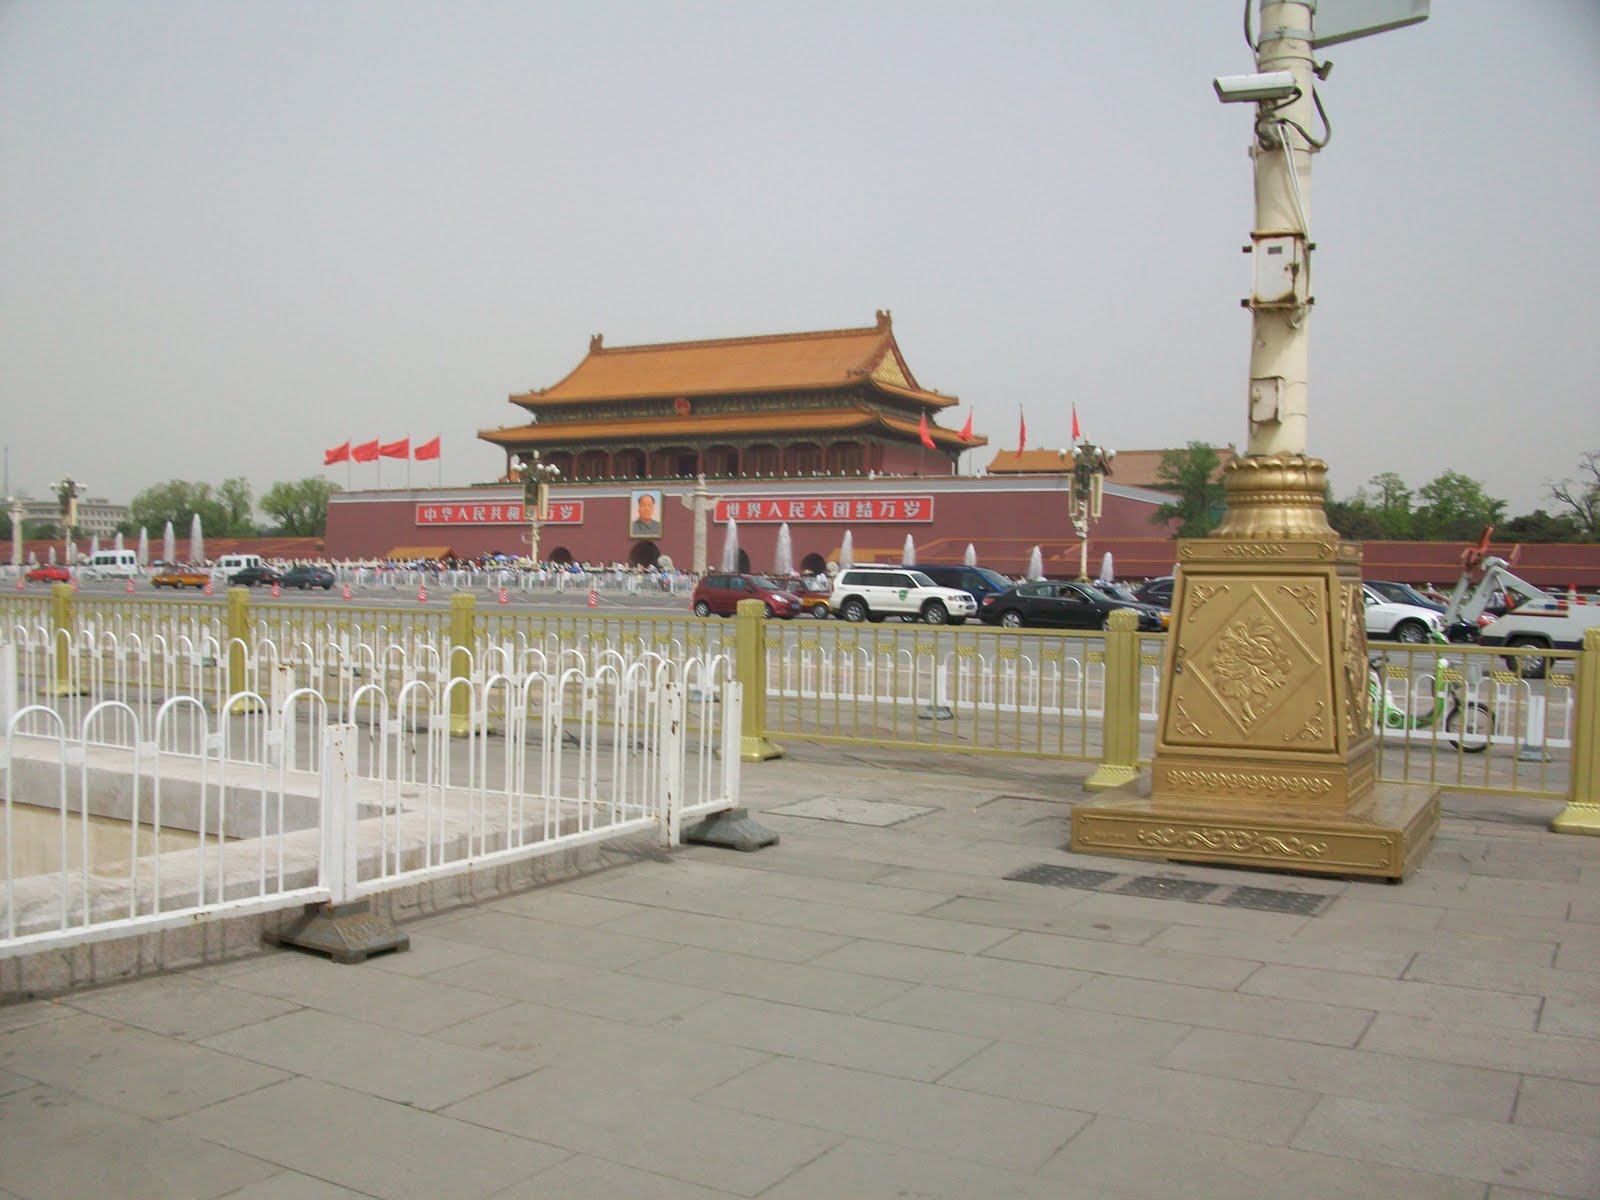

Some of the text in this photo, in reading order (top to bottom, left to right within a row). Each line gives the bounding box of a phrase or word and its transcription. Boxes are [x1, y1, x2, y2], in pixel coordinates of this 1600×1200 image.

[423, 505, 574, 522] 中华人民共和万岁
[725, 501, 921, 518] 世界人民大团结万岁
